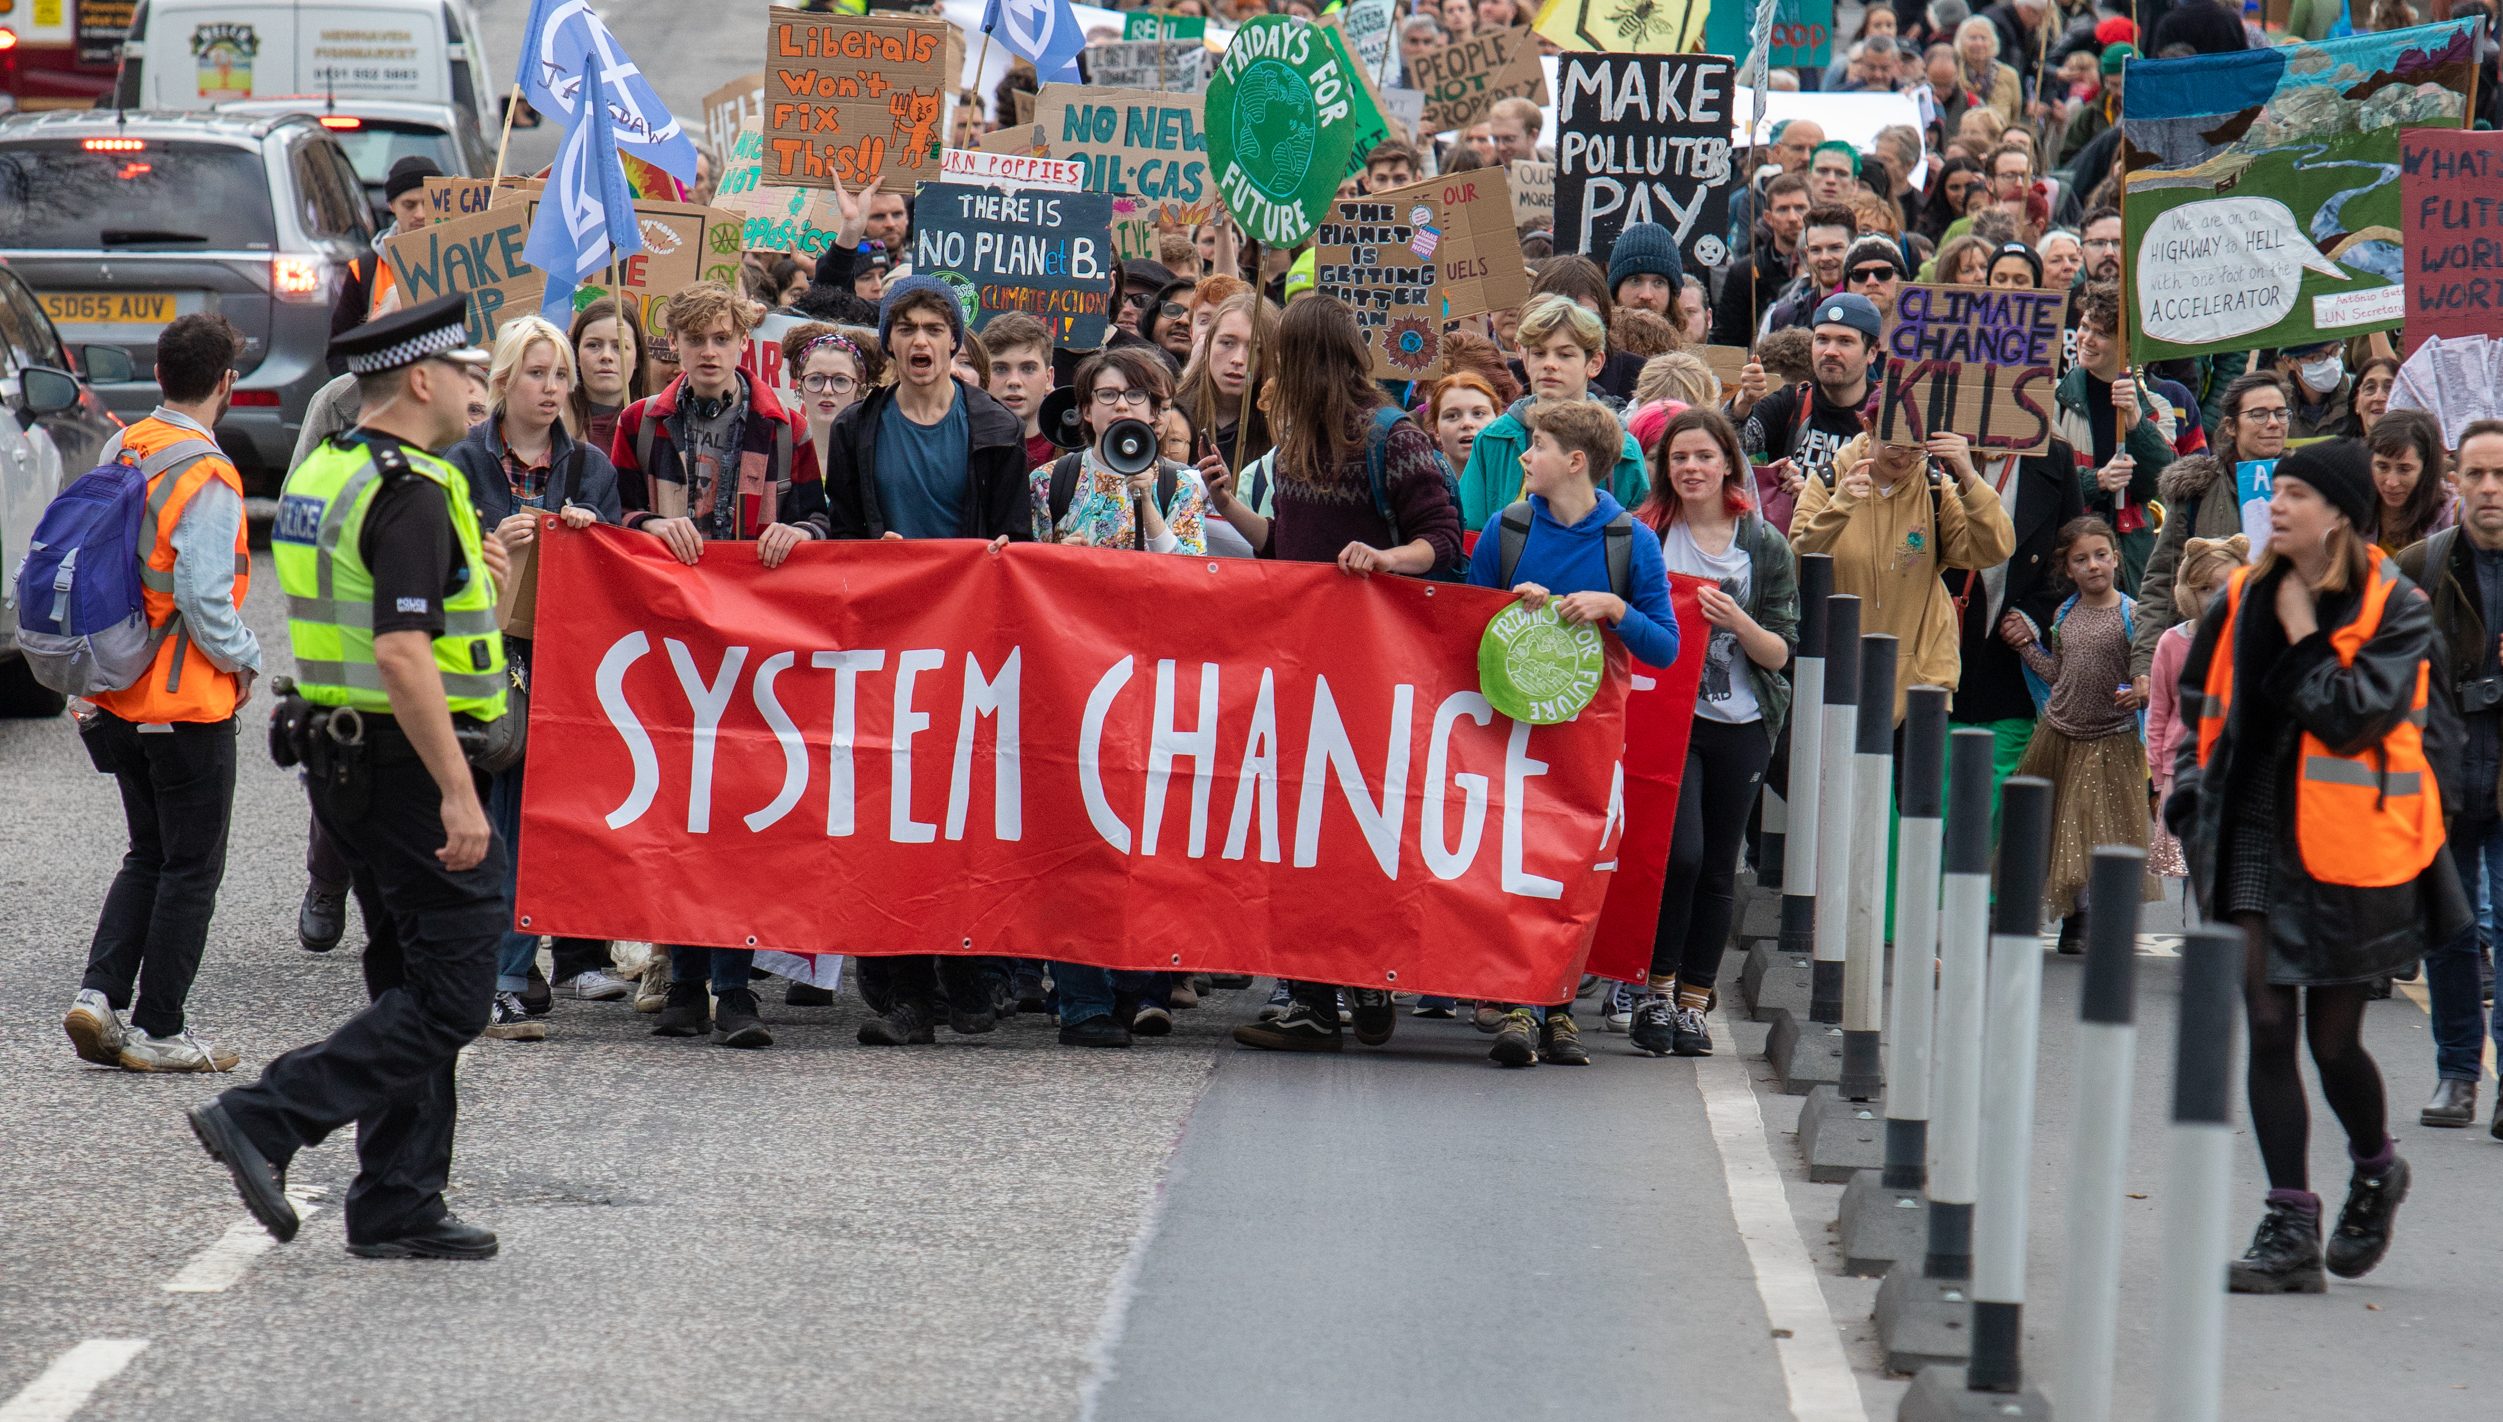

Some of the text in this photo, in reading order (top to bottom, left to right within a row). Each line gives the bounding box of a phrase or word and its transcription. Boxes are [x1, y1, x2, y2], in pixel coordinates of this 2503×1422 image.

[779, 24, 939, 63] Liberals
[778, 68, 888, 98] Won't
[1221, 22, 1349, 128] FRIDAYS FOR
[1424, 72, 1490, 106] NOT
[1560, 59, 1727, 123] MAKE
[773, 102, 840, 133] Fix
[1062, 103, 1208, 152] NO NEW
[772, 134, 886, 184] This!!
[989, 155, 1079, 184] POPPIES
[430, 187, 451, 213] WE
[957, 194, 1063, 228] THERE IS
[1220, 160, 1311, 243] FUTURE
[1443, 182, 1479, 206] OUR
[1339, 203, 1396, 222] THE
[1578, 176, 1708, 255] PAY
[2171, 209, 2259, 231] We are on a
[390, 224, 532, 303] WAKE
[918, 228, 965, 268] NO
[1351, 245, 1379, 266] IS
[2151, 229, 2285, 265] HIGHWAY to HELL
[1319, 264, 1437, 286] GETTING
[1446, 257, 1489, 281] UELS
[2192, 273, 2216, 288] one
[2220, 264, 2246, 284] foot
[2250, 267, 2265, 280] on
[2270, 261, 2291, 277] the
[48, 295, 166, 319] SD65 AUV
[981, 284, 1047, 313] CLIMATE
[1047, 288, 1108, 316] ACTION
[1897, 286, 2064, 330] CLIMATE
[2149, 285, 2281, 323] ACCELERATOR
[2325, 310, 2346, 323] UN
[1890, 323, 2058, 367] CHANGE
[1881, 358, 2055, 450] KILLS
[1529, 670, 1599, 721] FUTURE
[595, 630, 1022, 844] SYSTEM
[1078, 654, 1564, 901] CHANGE
